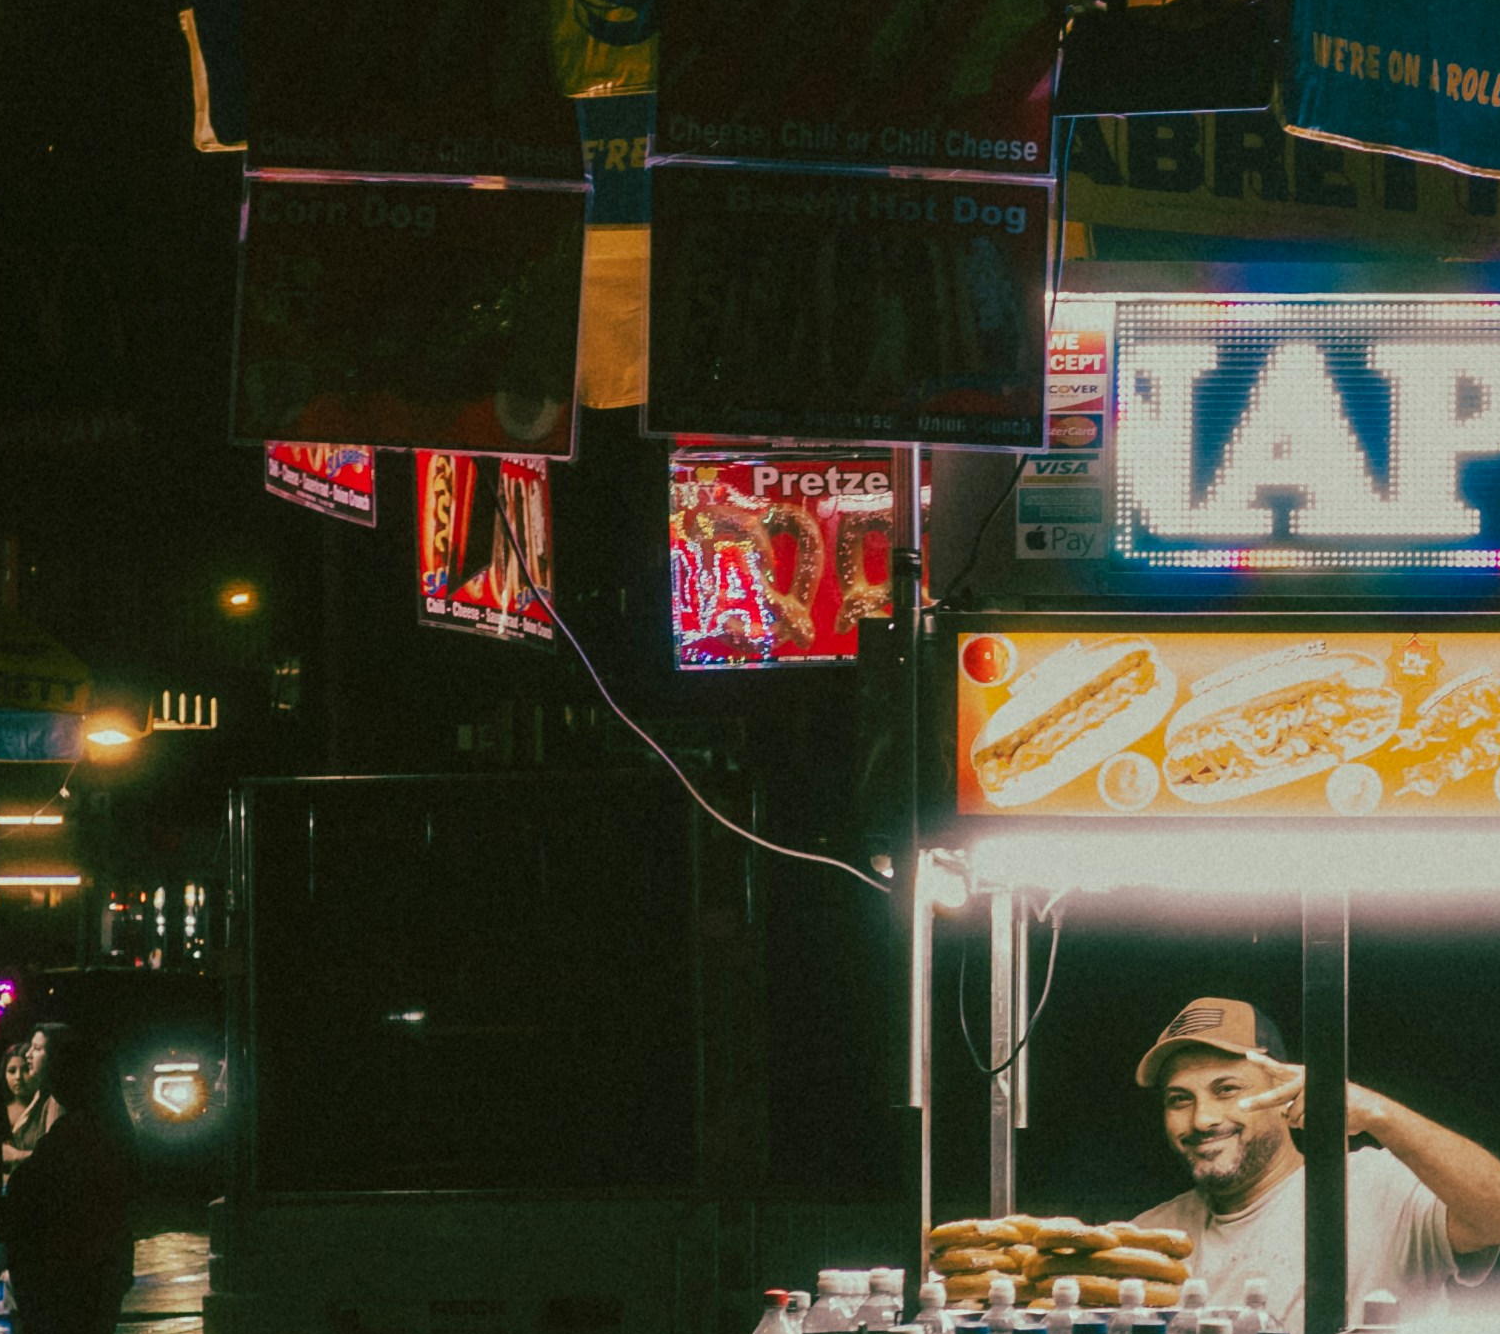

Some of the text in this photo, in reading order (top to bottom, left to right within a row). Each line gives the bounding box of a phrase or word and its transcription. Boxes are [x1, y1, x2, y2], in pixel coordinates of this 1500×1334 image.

[1389, 50, 1420, 88] ON
[944, 128, 1040, 163] Cheese
[362, 193, 438, 238] Dog
[951, 195, 1029, 237] Dog
[1048, 333, 1080, 351] WE
[1049, 354, 1104, 371] CEPT
[1048, 385, 1099, 394] COVER
[753, 466, 889, 497] Pretze
[1035, 462, 1089, 475] VISA
[1052, 527, 1096, 557] Pay
